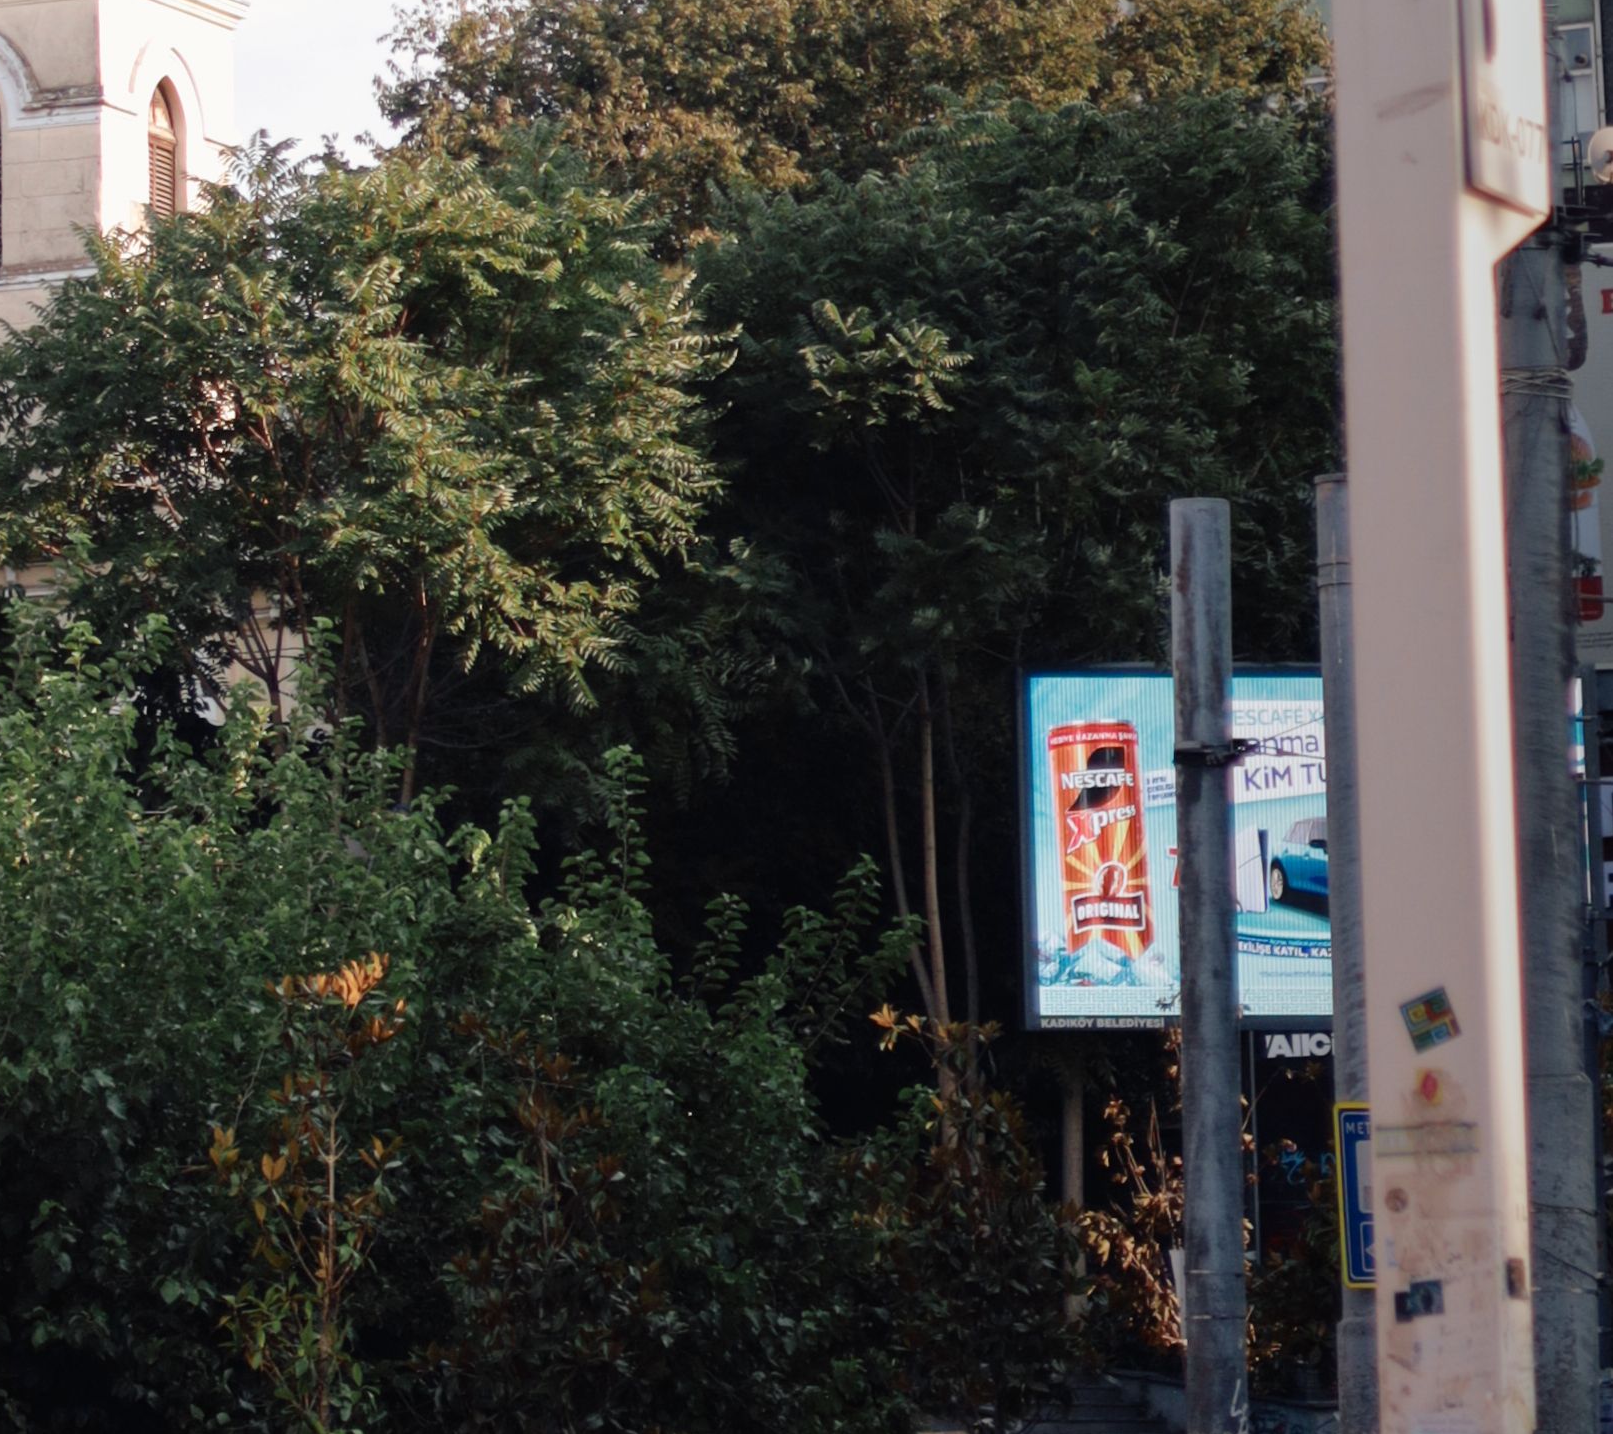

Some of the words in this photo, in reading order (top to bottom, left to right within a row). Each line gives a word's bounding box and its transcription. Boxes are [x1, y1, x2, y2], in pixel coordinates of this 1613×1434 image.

[1077, 902, 1139, 920] ORIGINAL
[1041, 1016, 1094, 1028] KADIKÖY
[1096, 1016, 1165, 1028] BELEDİYESİ
